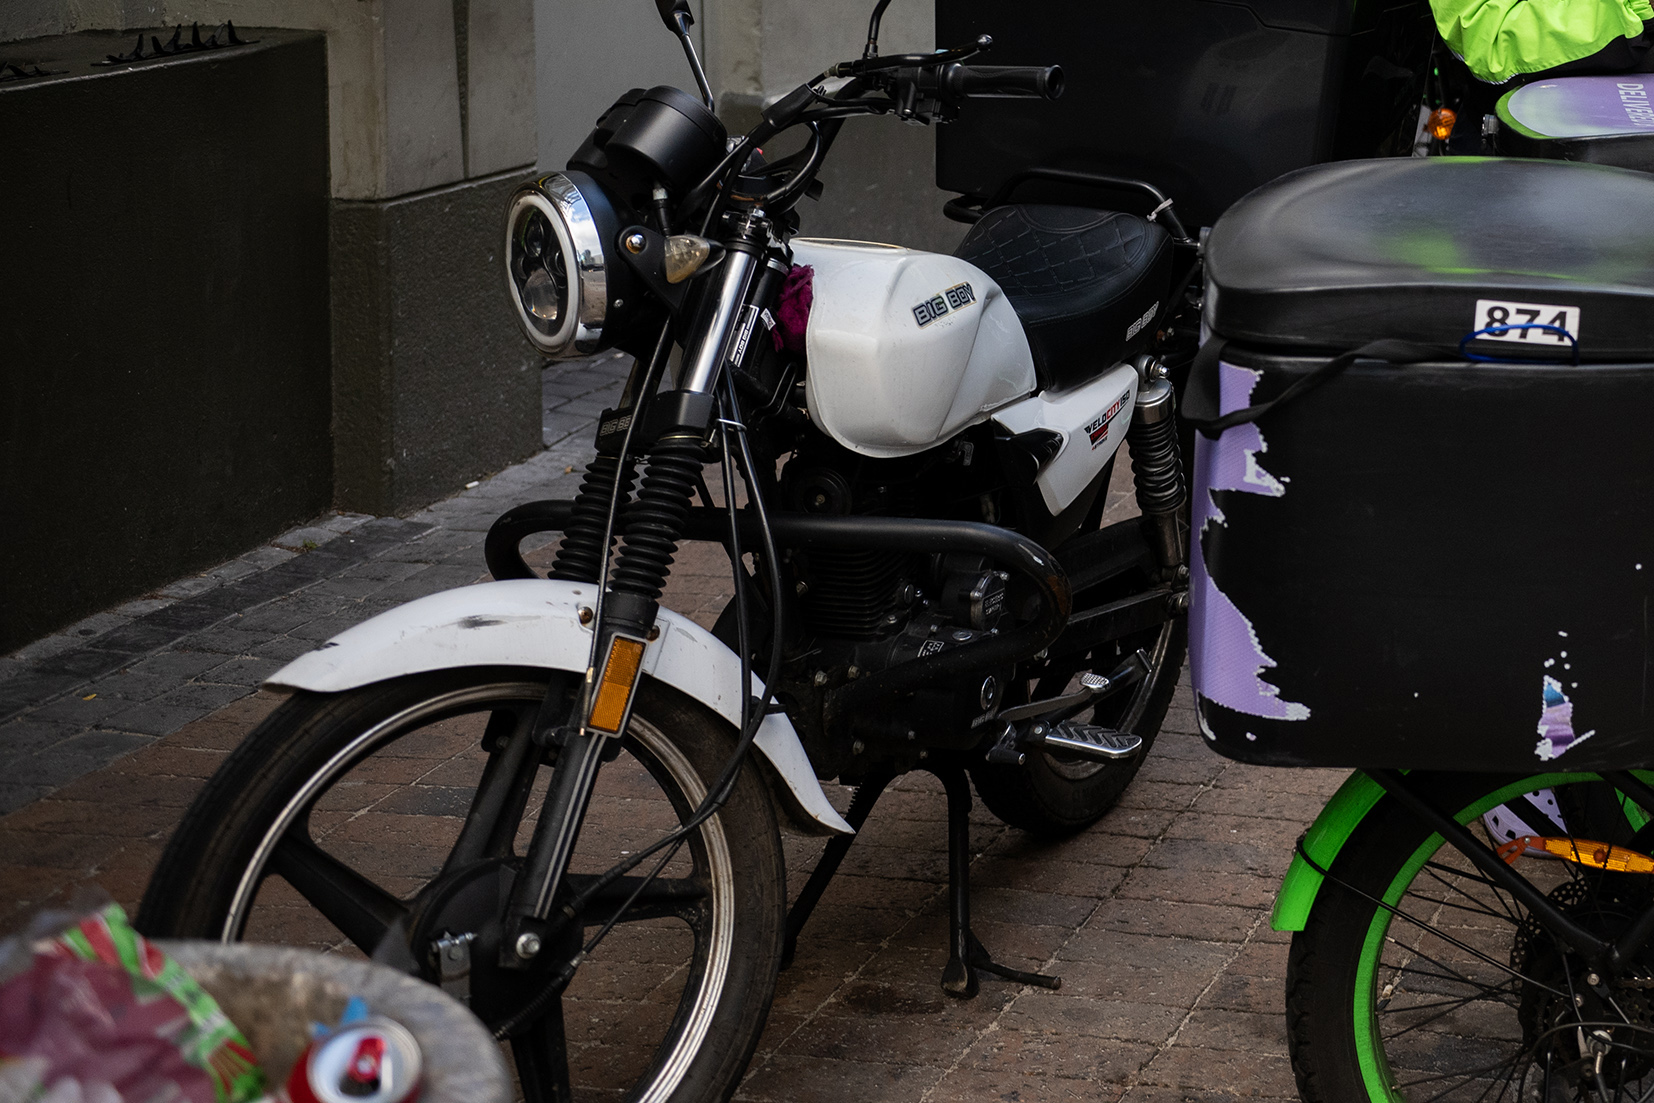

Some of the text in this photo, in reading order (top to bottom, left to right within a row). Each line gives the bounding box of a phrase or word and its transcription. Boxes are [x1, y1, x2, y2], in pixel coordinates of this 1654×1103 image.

[913, 282, 976, 327] BIG BOY
[1484, 306, 1570, 342] 874
[616, 415, 632, 432] BO
